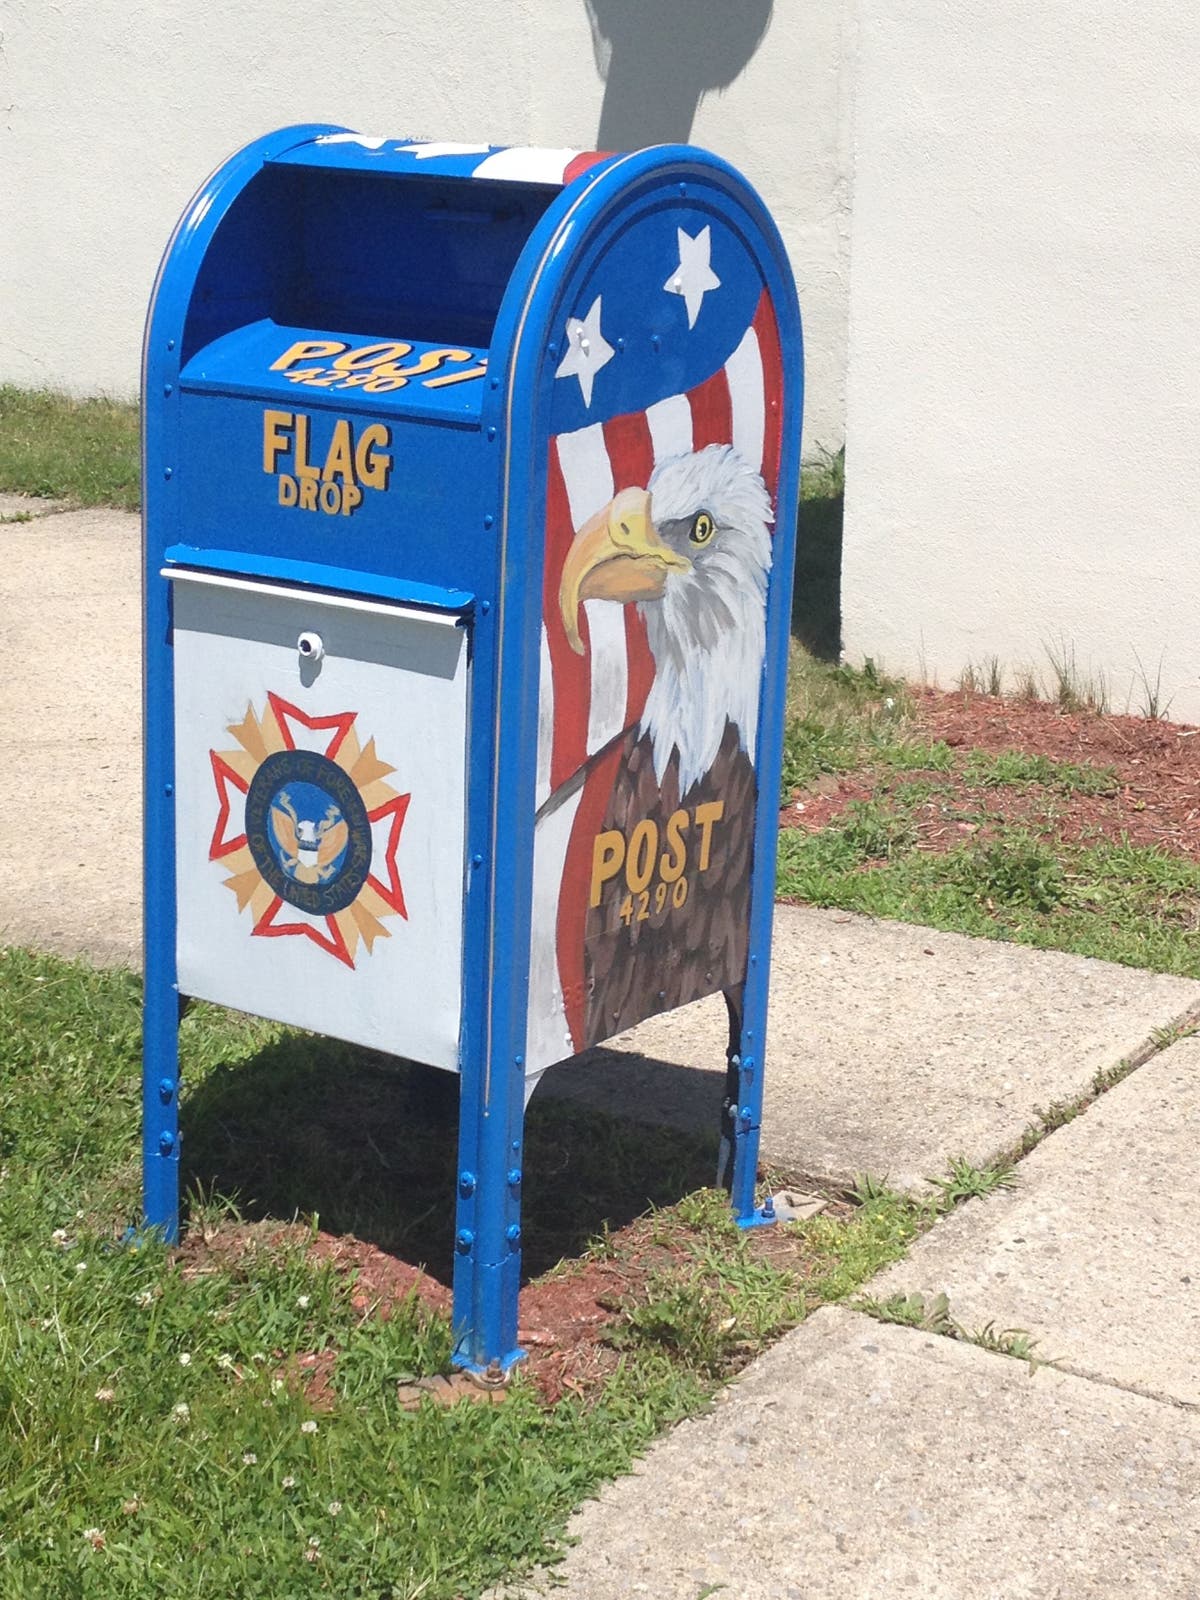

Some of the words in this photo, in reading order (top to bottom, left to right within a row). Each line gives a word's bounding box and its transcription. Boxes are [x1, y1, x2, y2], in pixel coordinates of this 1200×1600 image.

[283, 367, 409, 393] 4290
[263, 409, 391, 490] FLAG
[278, 474, 362, 516] DROP
[590, 800, 724, 909] POST
[620, 876, 688, 926] 4290
